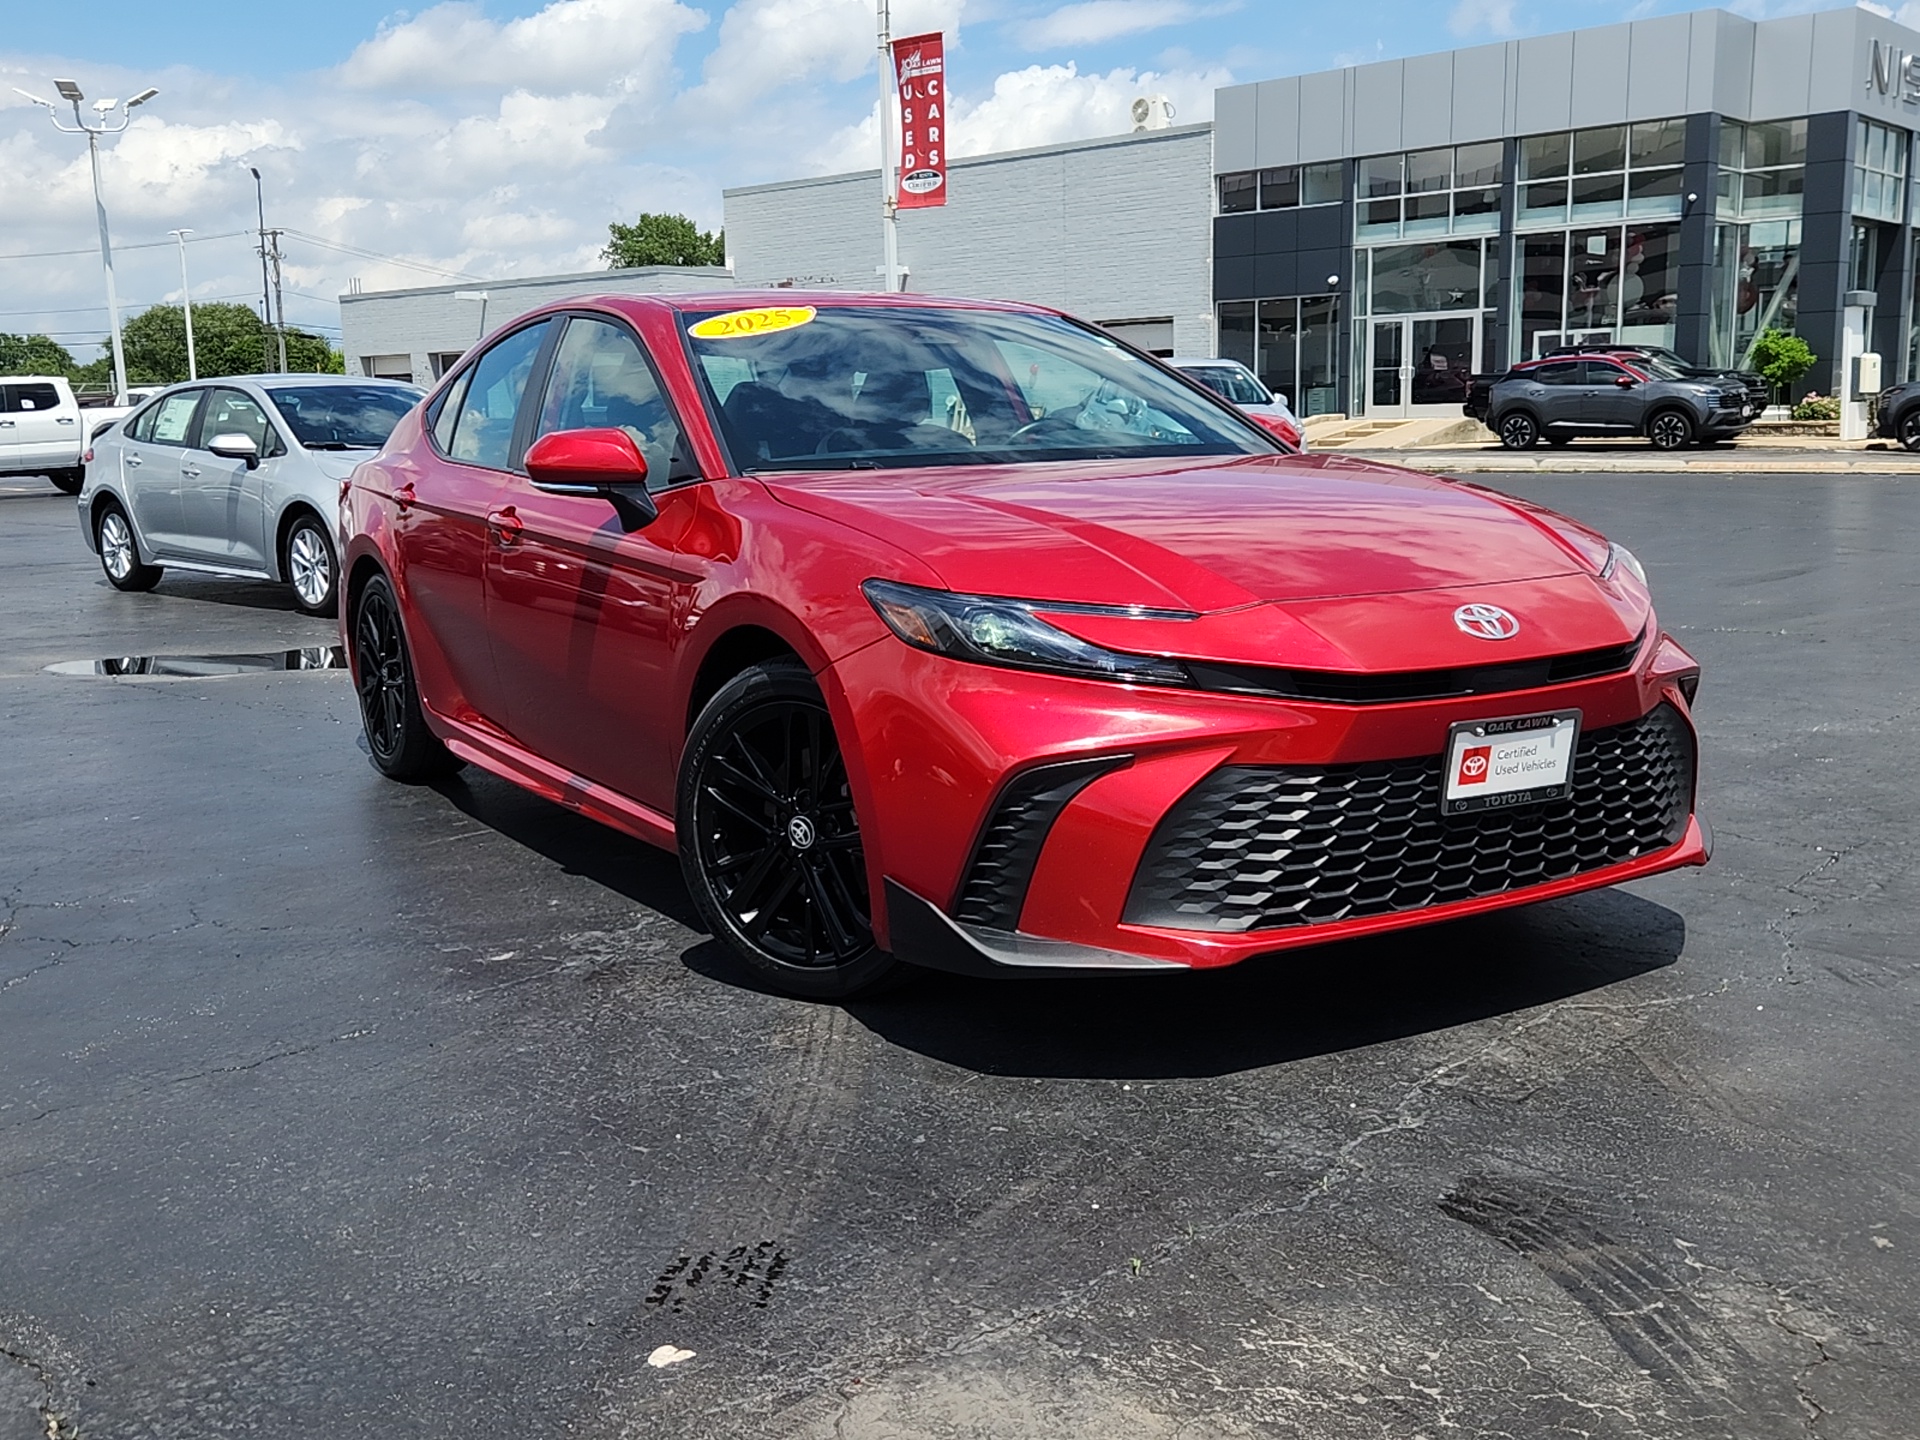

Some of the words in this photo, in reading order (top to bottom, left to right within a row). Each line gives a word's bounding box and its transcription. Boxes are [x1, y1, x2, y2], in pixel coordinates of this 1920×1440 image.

[903, 84, 915, 169] USED
[927, 79, 941, 166] CARS
[715, 309, 791, 335] 2025
[1488, 721, 1514, 733] OAK
[1517, 716, 1551, 729] LAWN
[1497, 745, 1537, 760] Certified
[1495, 762, 1519, 775] Used
[1521, 758, 1556, 772] Vehicles
[1484, 792, 1532, 807] TOYOTA
